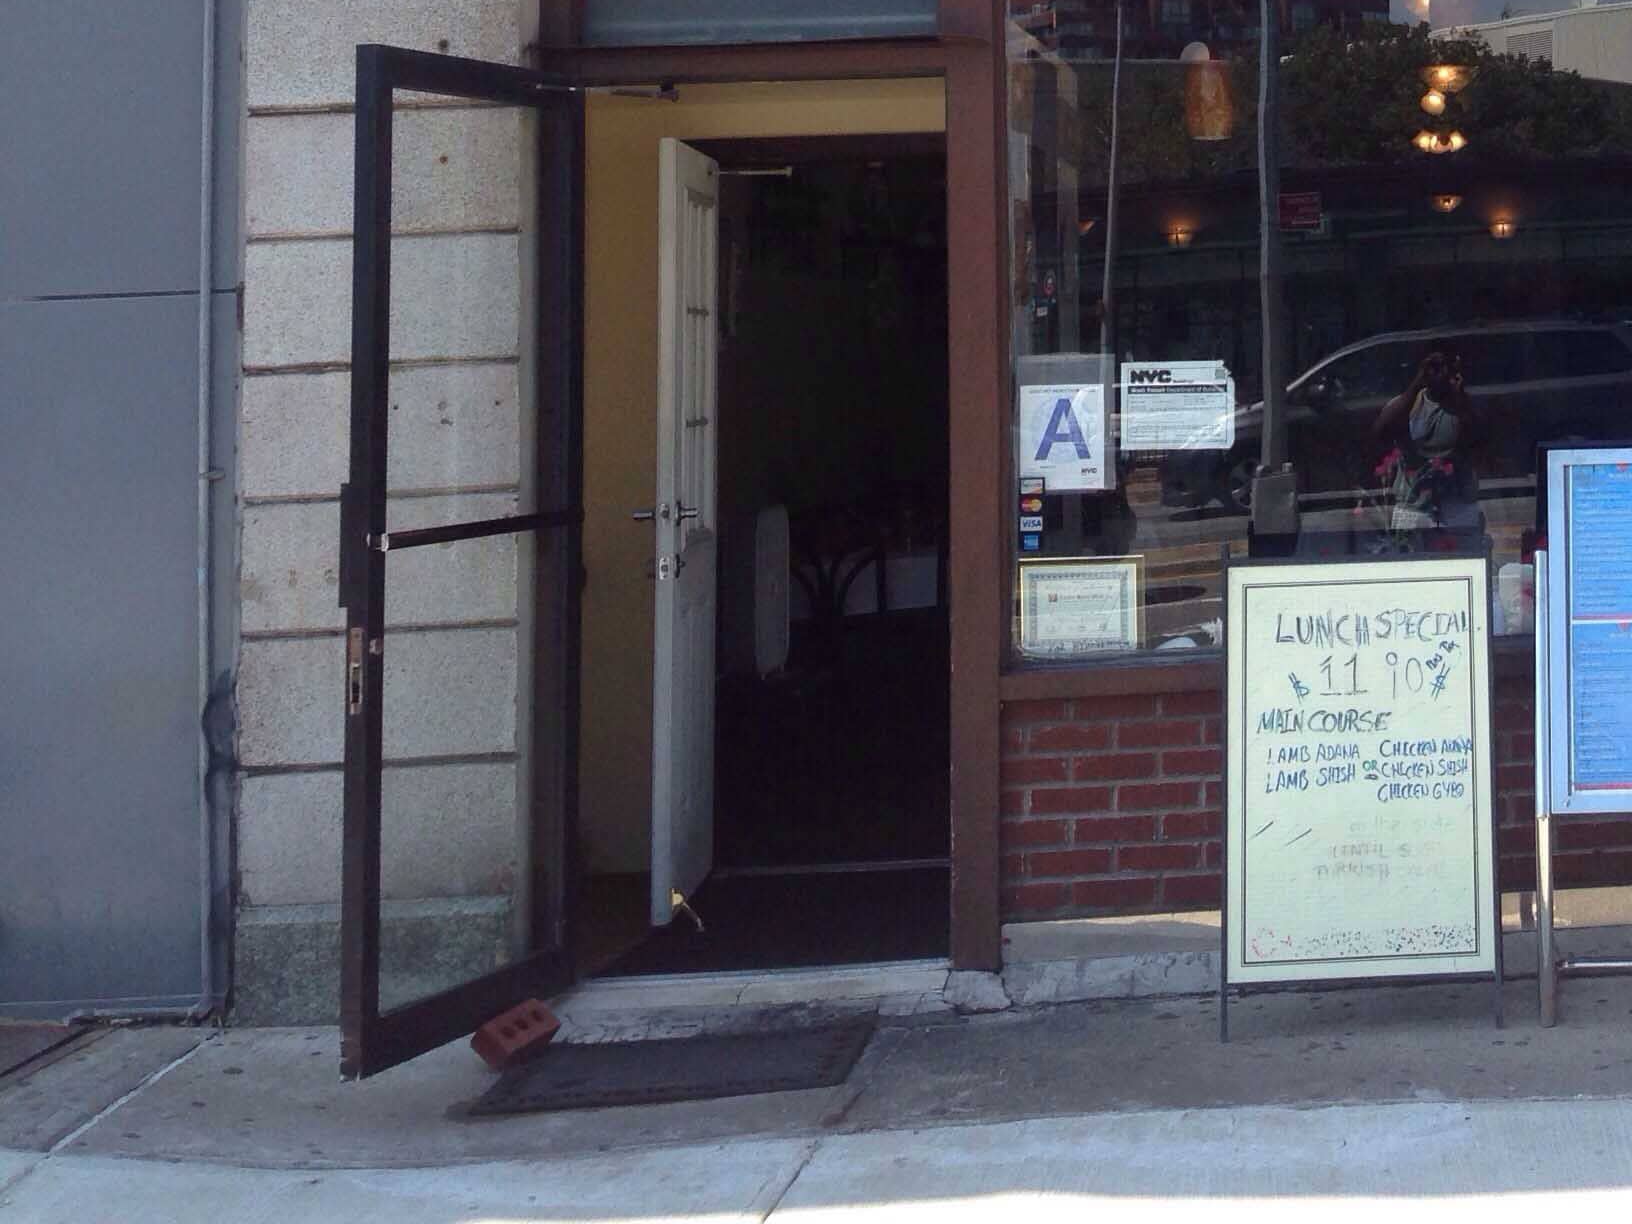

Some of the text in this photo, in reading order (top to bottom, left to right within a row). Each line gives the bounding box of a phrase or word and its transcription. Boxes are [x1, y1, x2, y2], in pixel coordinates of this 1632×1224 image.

[1130, 369, 1172, 384] NYC
[1034, 398, 1091, 460] A
[1022, 519, 1042, 529] VISA
[1275, 609, 1370, 648] LUNCH
[1256, 708, 1393, 734] MAIN COURSE
[1266, 743, 1360, 765] LAMB ADANA
[1379, 738, 1437, 757] CHICKEN
[1265, 769, 1309, 794] LAMB
[1315, 762, 1356, 787] SHISH
